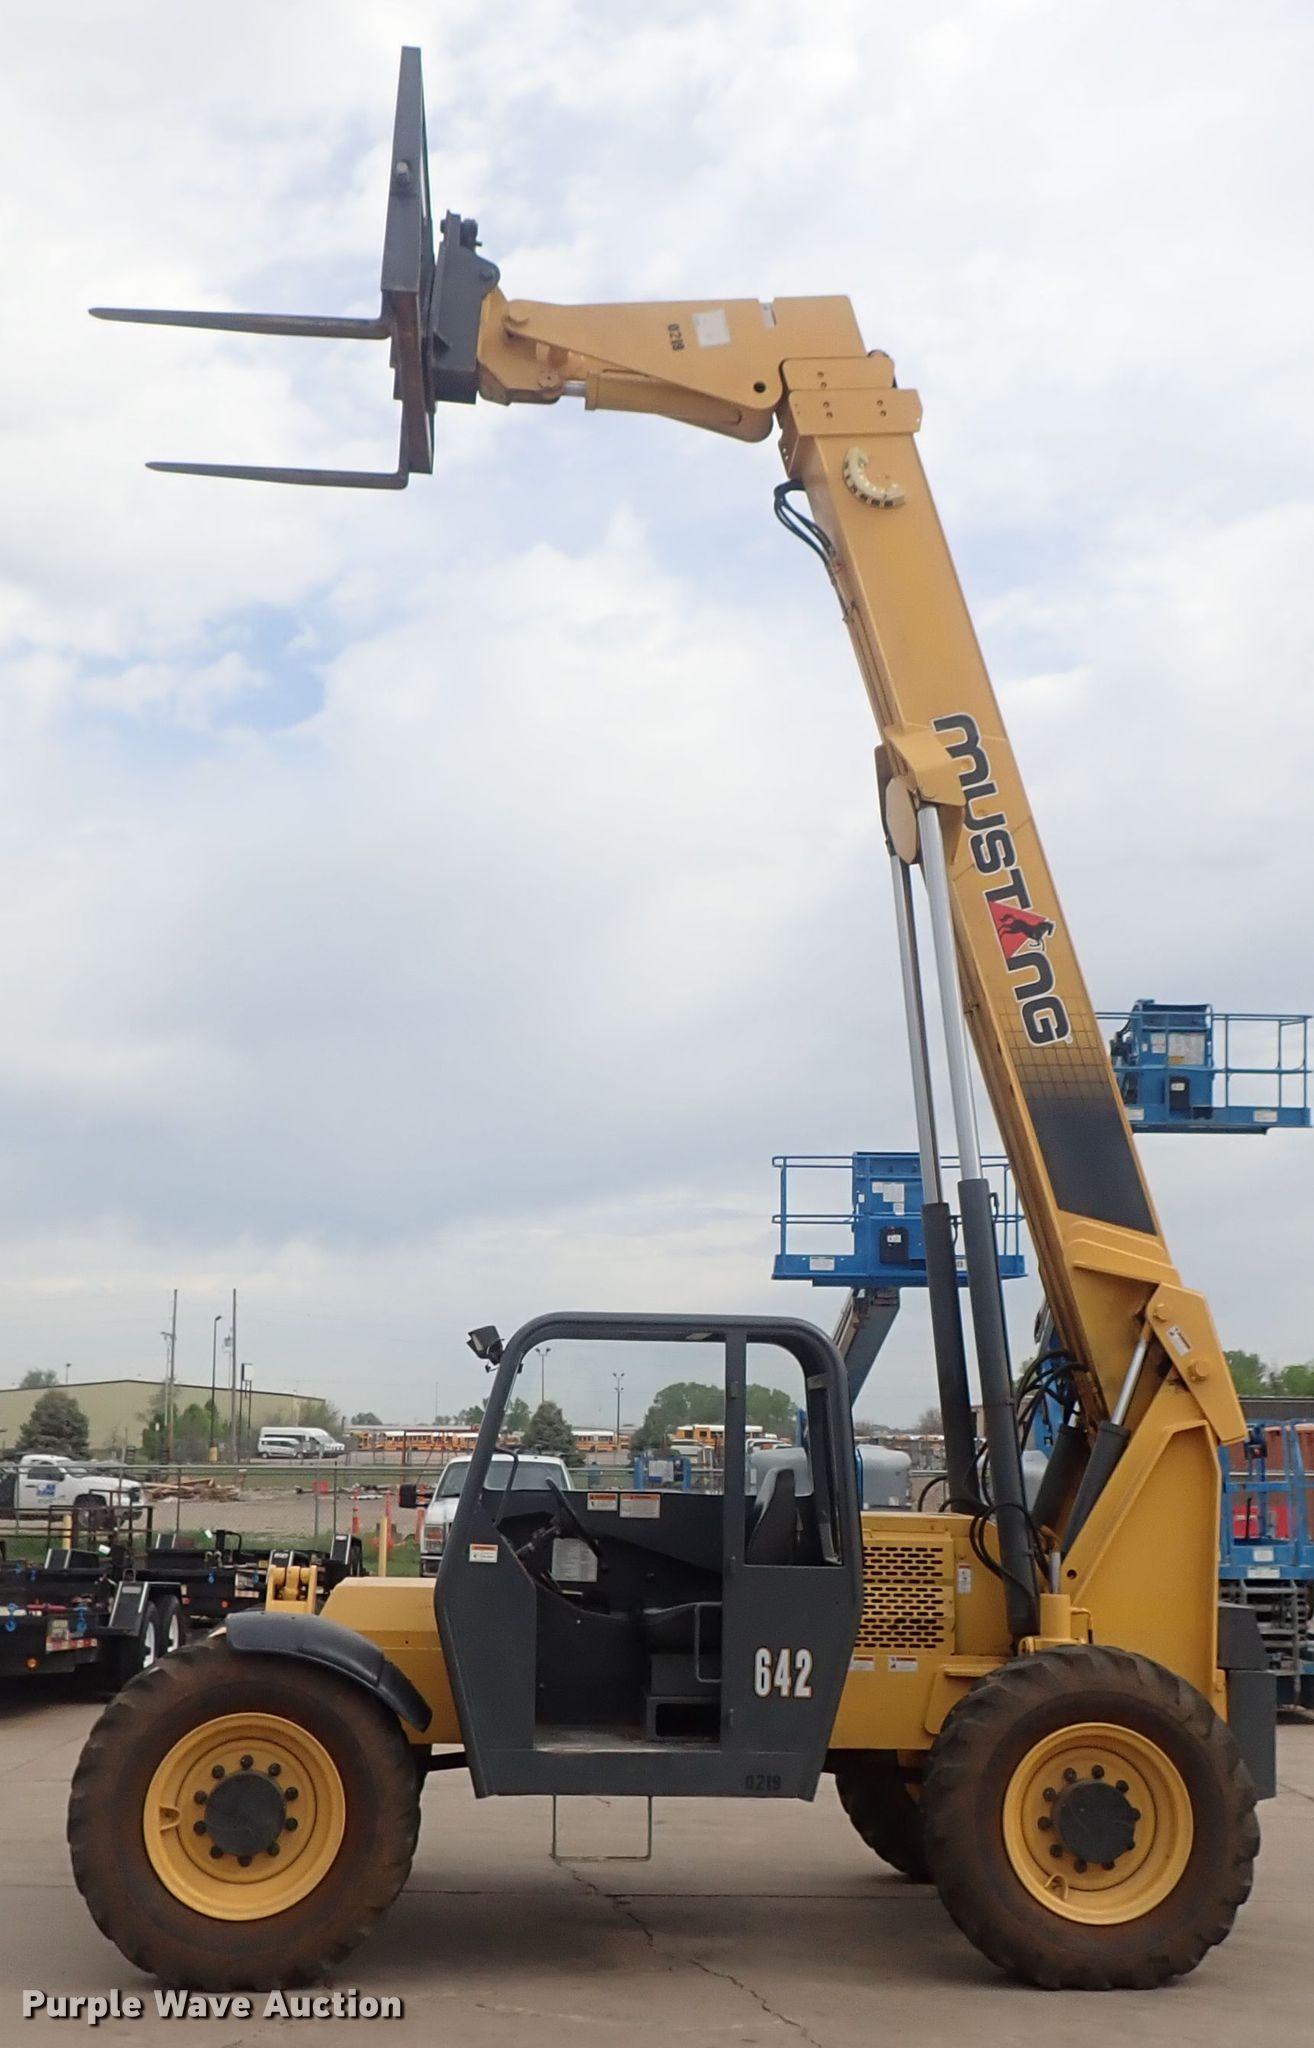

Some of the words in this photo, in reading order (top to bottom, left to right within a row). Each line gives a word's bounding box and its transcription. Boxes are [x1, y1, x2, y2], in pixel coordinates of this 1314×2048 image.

[931, 712, 1070, 1045] MUSTANG
[754, 1647, 813, 1698] 642
[745, 1775, 782, 1791] 0219
